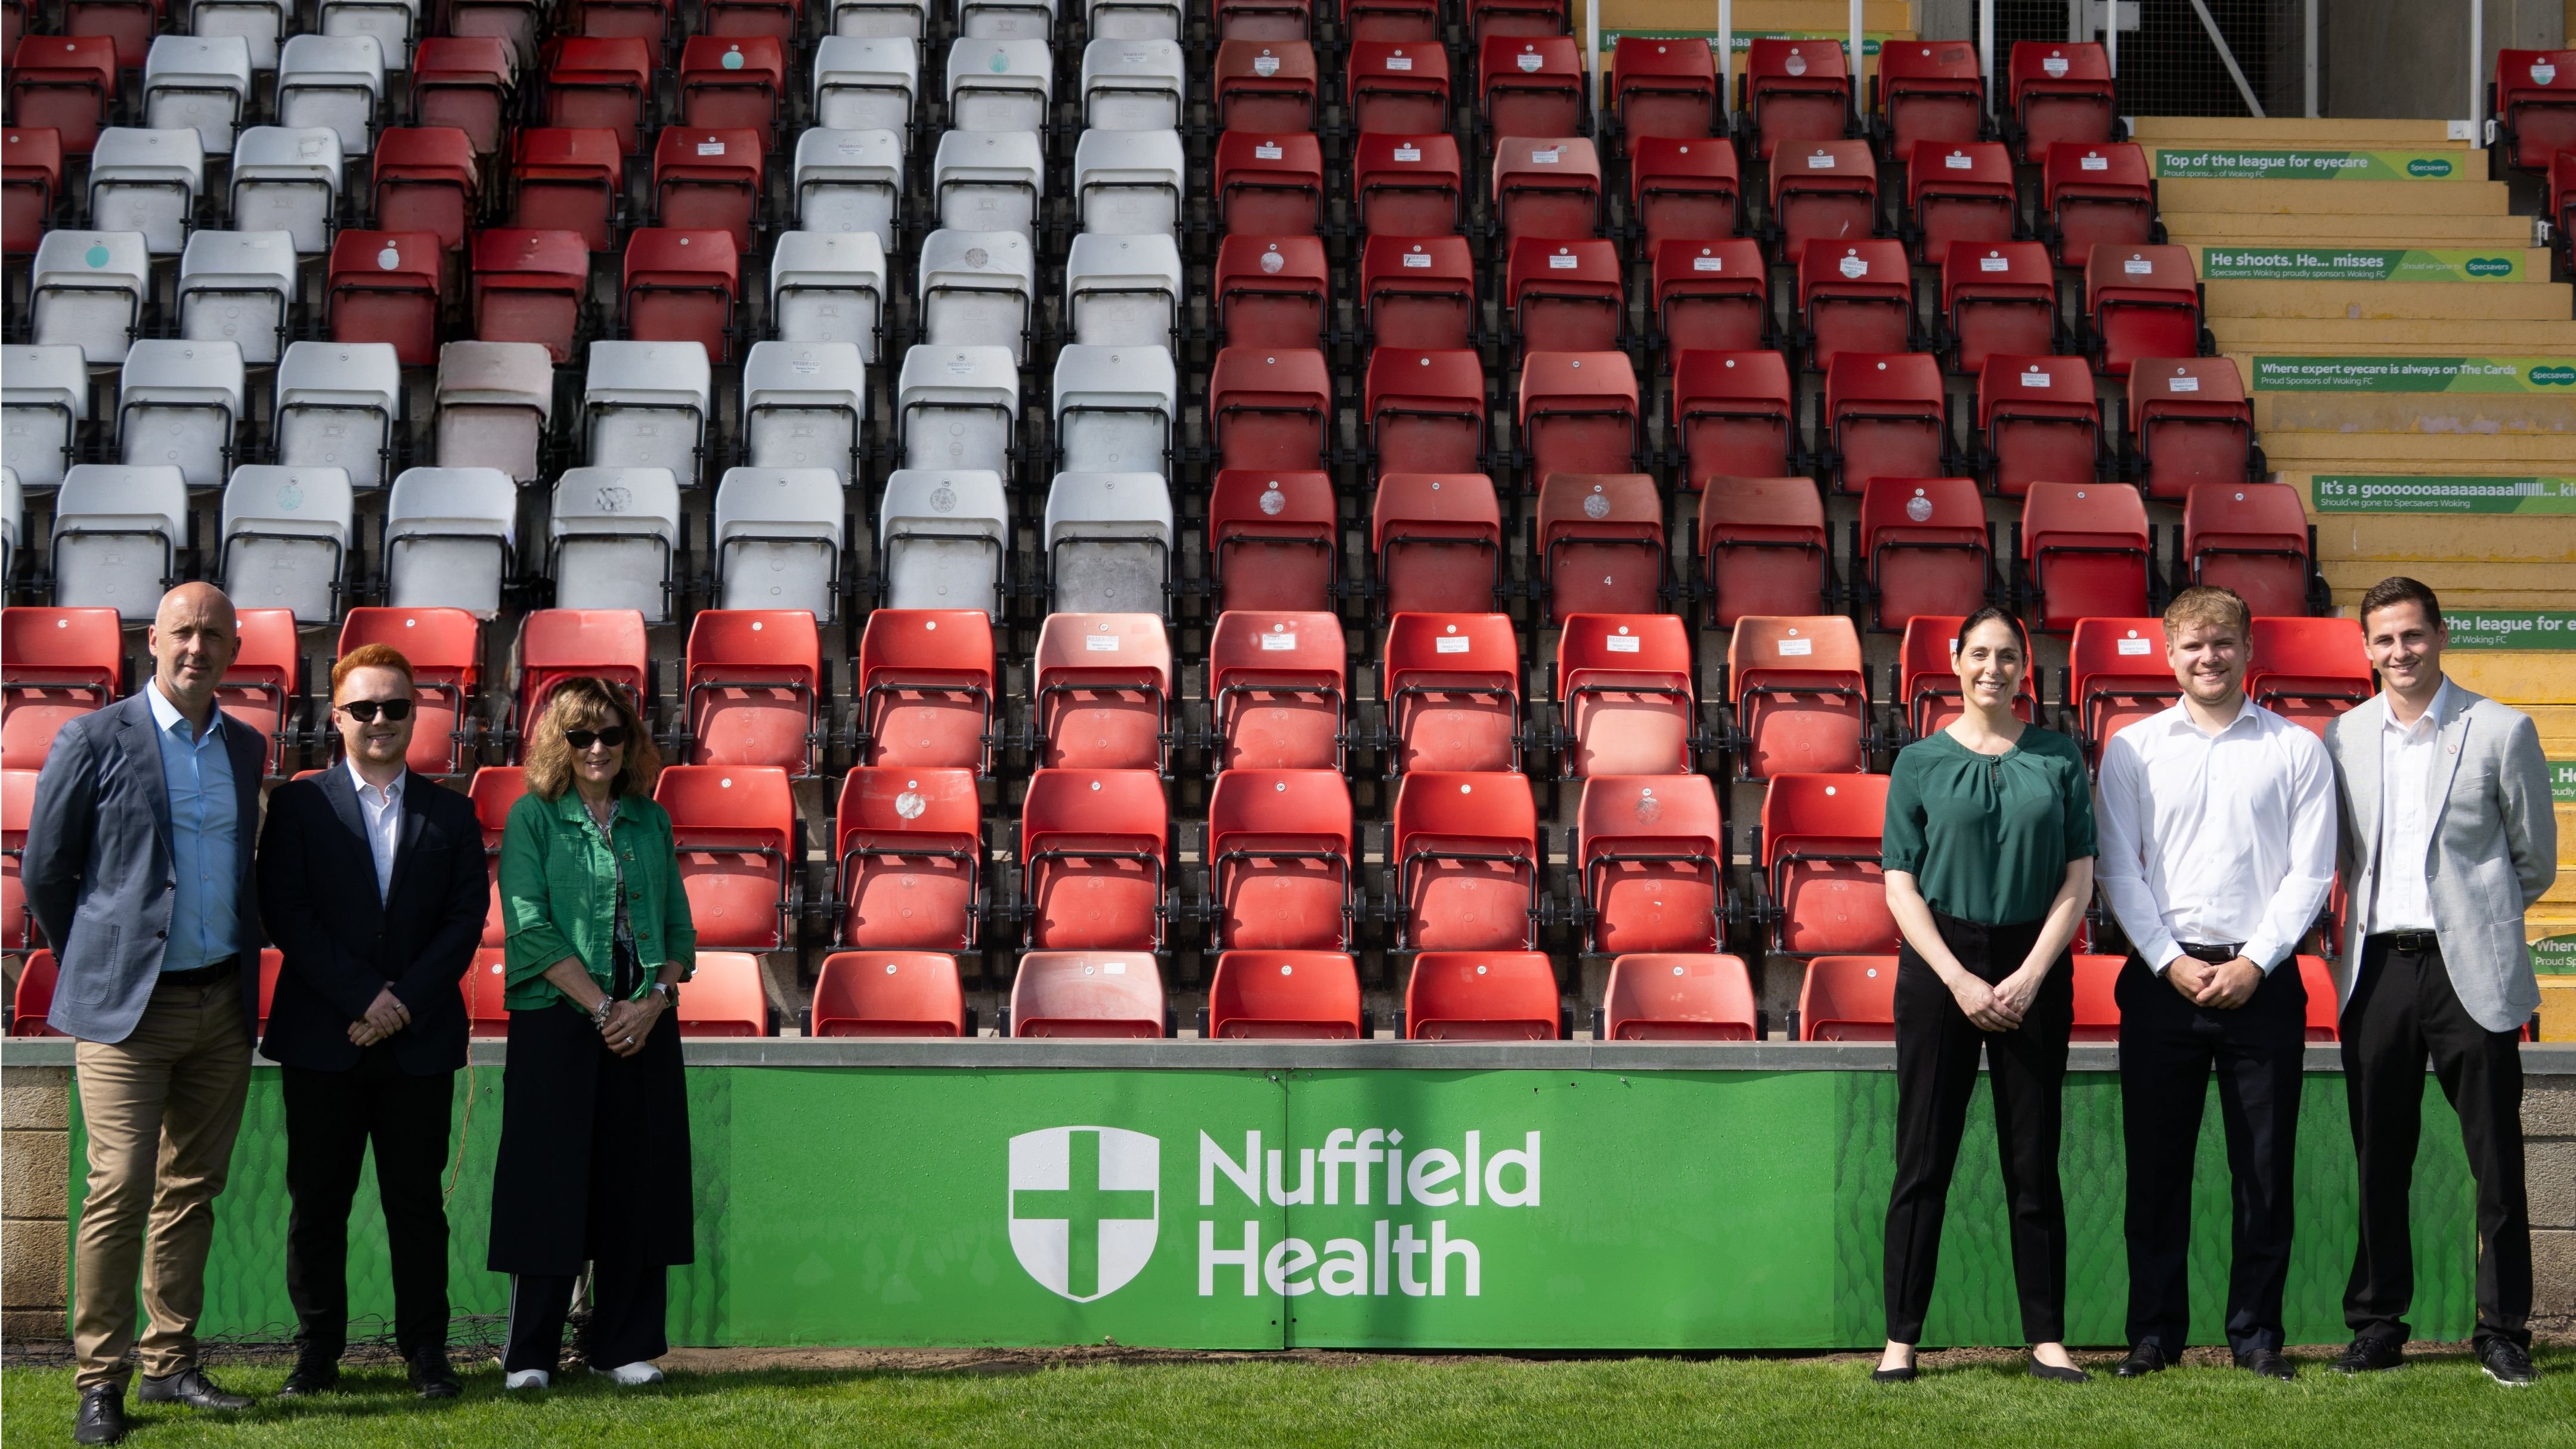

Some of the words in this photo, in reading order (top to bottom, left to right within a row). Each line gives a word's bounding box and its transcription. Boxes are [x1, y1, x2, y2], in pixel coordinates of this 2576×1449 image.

[1606, 33, 1620, 45] It'
[2164, 154, 2190, 169] Top
[2193, 154, 2209, 167] of
[2212, 155, 2236, 167] the
[2239, 155, 2286, 169] league
[2289, 155, 2310, 168] for
[2314, 157, 2368, 170] eyecare
[2211, 253, 2232, 266] He
[2236, 253, 2293, 267] shoots.
[2297, 254, 2329, 267] He...
[2333, 253, 2384, 267] misses
[2211, 269, 2251, 277] Specsavers
[2283, 270, 2310, 278] proudly
[2347, 271, 2374, 279] Woking
[2262, 364, 2299, 373] Where
[2302, 364, 2341, 376] expert
[2343, 366, 2388, 376] eyecare
[2390, 364, 2399, 374] is
[2401, 364, 2440, 376] always
[2443, 366, 2457, 374] on
[2460, 365, 2481, 374] The
[2484, 365, 2516, 375] Cards
[2286, 377, 2321, 385] Sponsors
[2333, 377, 2361, 386] Woking
[2321, 480, 2343, 494] It's
[2348, 485, 2357, 494] a
[2560, 482, 2576, 496] ki
[2394, 499, 2438, 507] Specsavers
[2440, 500, 2470, 508] Woking
[1604, 576, 1612, 585] 4
[2476, 616, 2532, 634] league
[2537, 615, 2563, 630] for
[2451, 635, 2460, 643] of
[2462, 636, 2494, 645] Woking
[2552, 787, 2576, 797] oudly
[2537, 940, 2576, 952] Wher
[2535, 956, 2564, 965] Proud
[1199, 1128, 1540, 1208] Nuffield
[1199, 1219, 1480, 1296] Health
